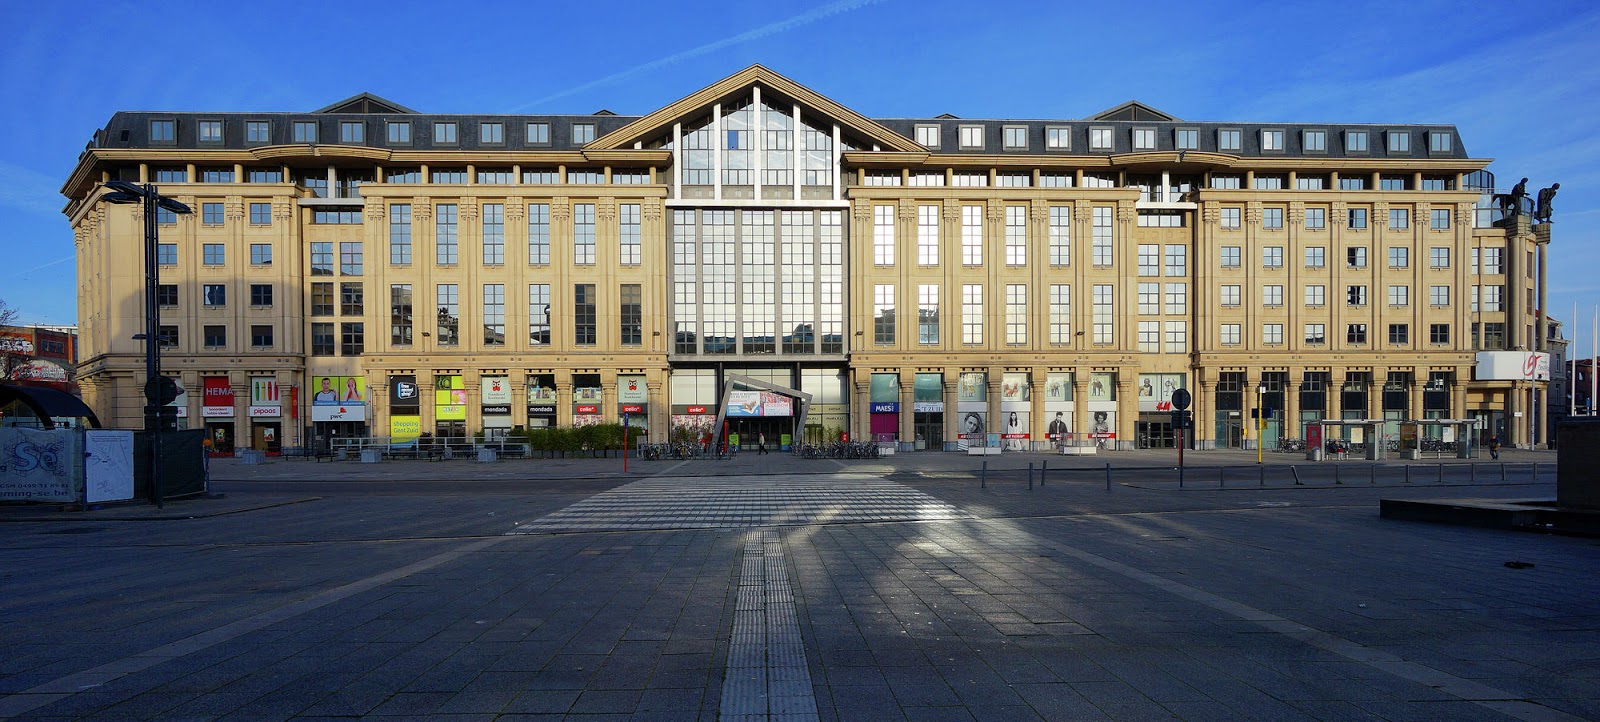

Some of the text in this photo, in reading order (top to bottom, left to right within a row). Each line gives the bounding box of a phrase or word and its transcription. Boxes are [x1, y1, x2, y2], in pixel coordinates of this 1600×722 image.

[206, 387, 234, 396] HEMA
[1155, 401, 1171, 411] H&M
[253, 408, 276, 416] pipoos
